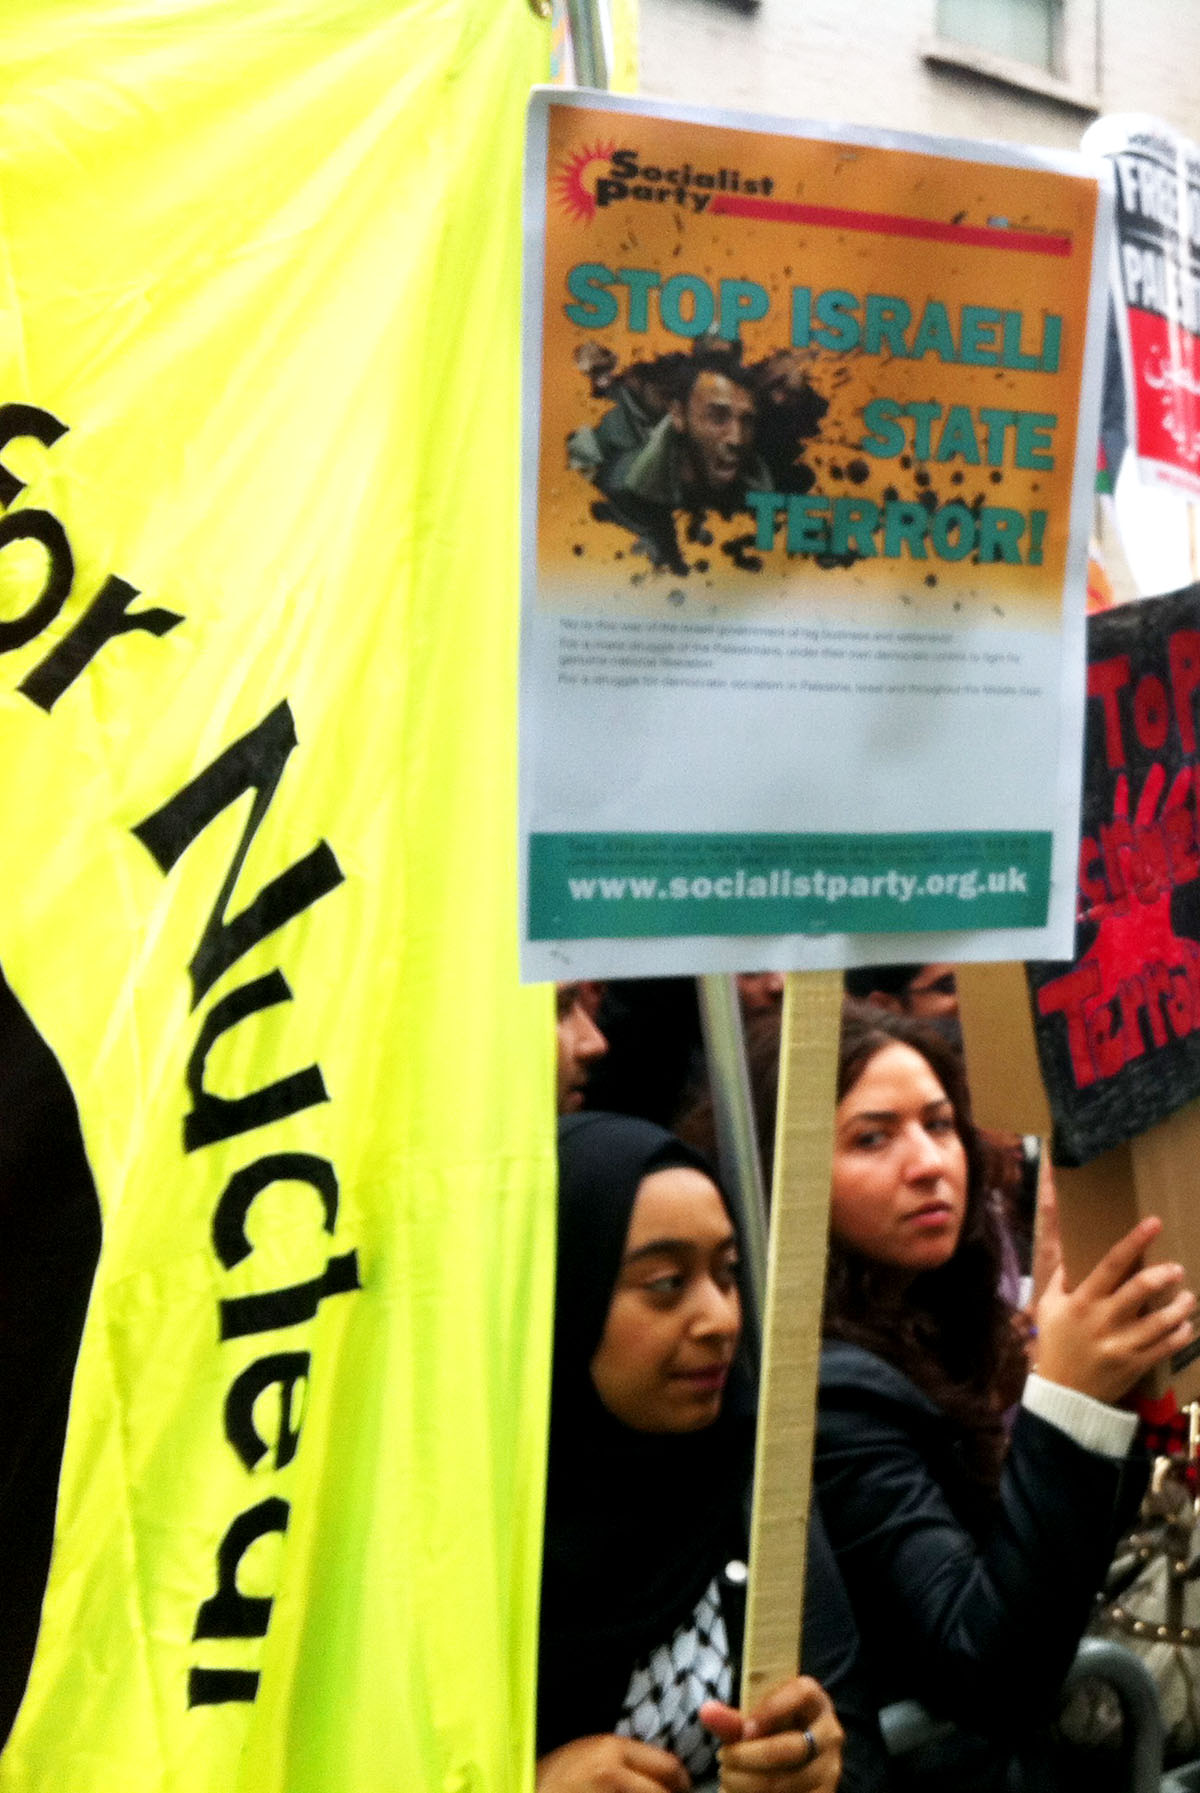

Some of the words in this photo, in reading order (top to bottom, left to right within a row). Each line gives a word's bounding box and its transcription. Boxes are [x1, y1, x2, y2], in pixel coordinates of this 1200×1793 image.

[609, 149, 775, 197] Socialist
[564, 262, 770, 341] STOP
[790, 285, 1063, 373] ISRAELI
[860, 399, 1057, 471] STATE
[745, 490, 1049, 566] TERROR!
[566, 865, 1028, 904] www.socialistparty.org.uk
